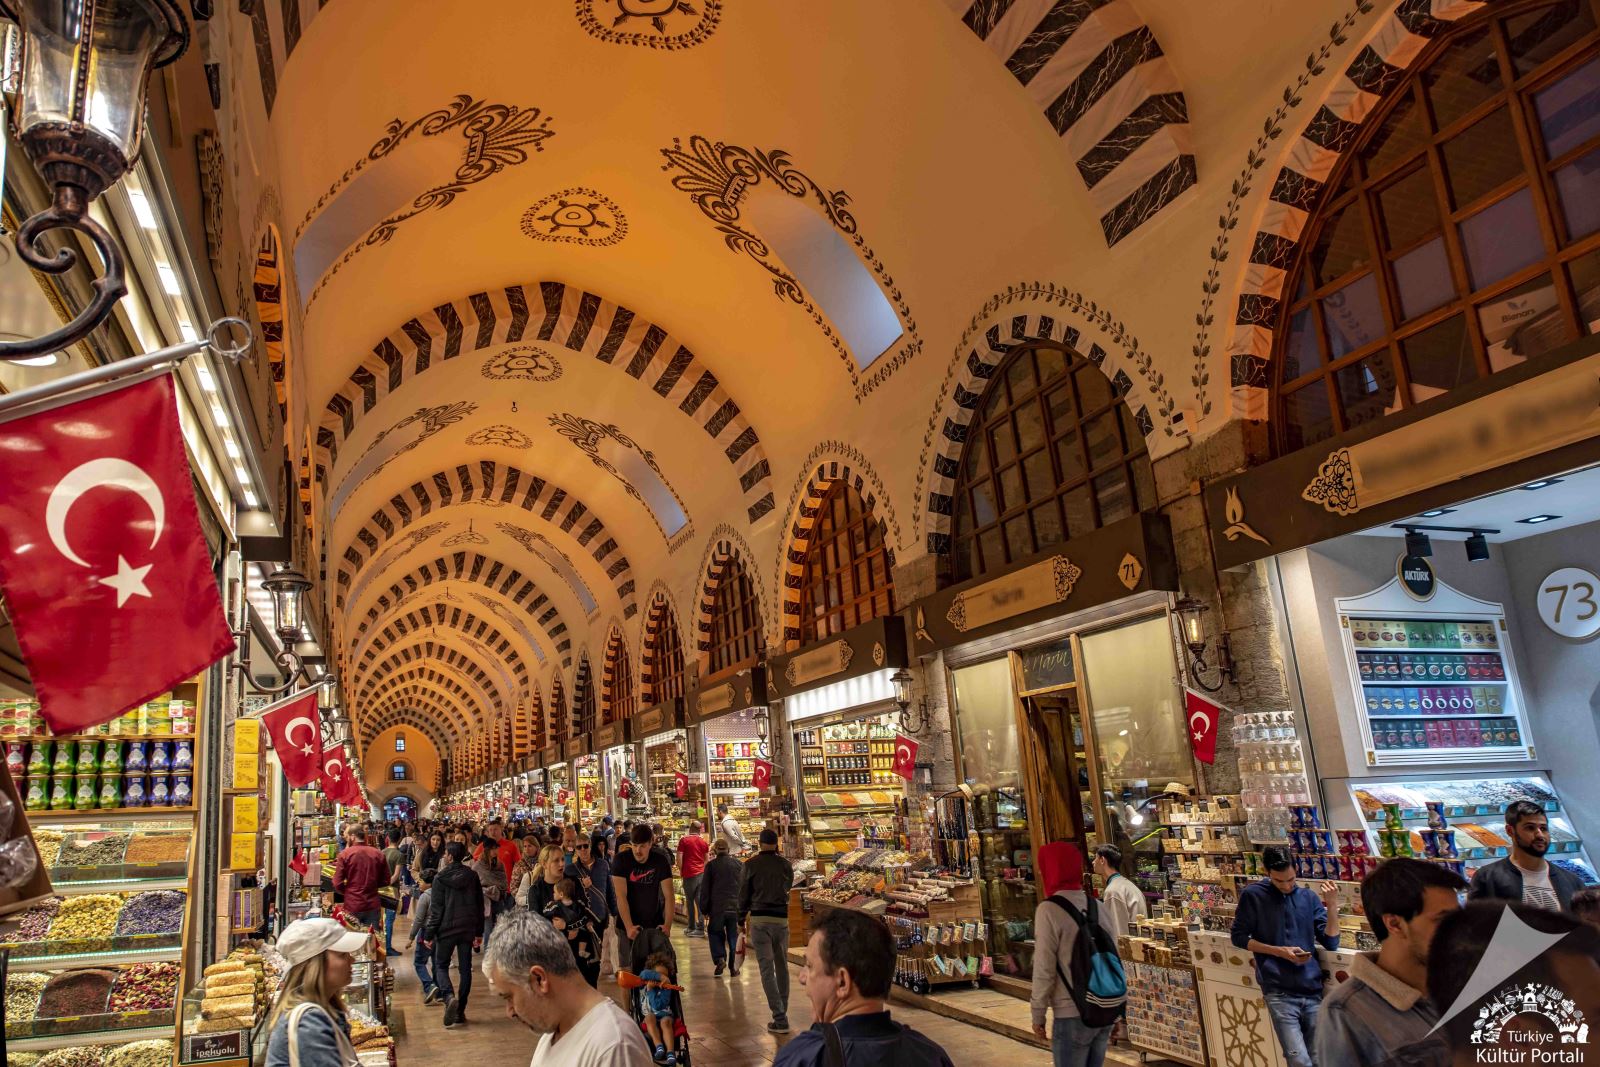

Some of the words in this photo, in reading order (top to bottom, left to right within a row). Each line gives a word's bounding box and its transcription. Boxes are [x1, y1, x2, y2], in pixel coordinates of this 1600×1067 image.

[1123, 562, 1136, 580] 71
[1404, 567, 1430, 581] AKTÜRK
[1545, 582, 1598, 623] 73
[874, 648, 882, 661] 69
[196, 1046, 235, 1058] ipekyolu
